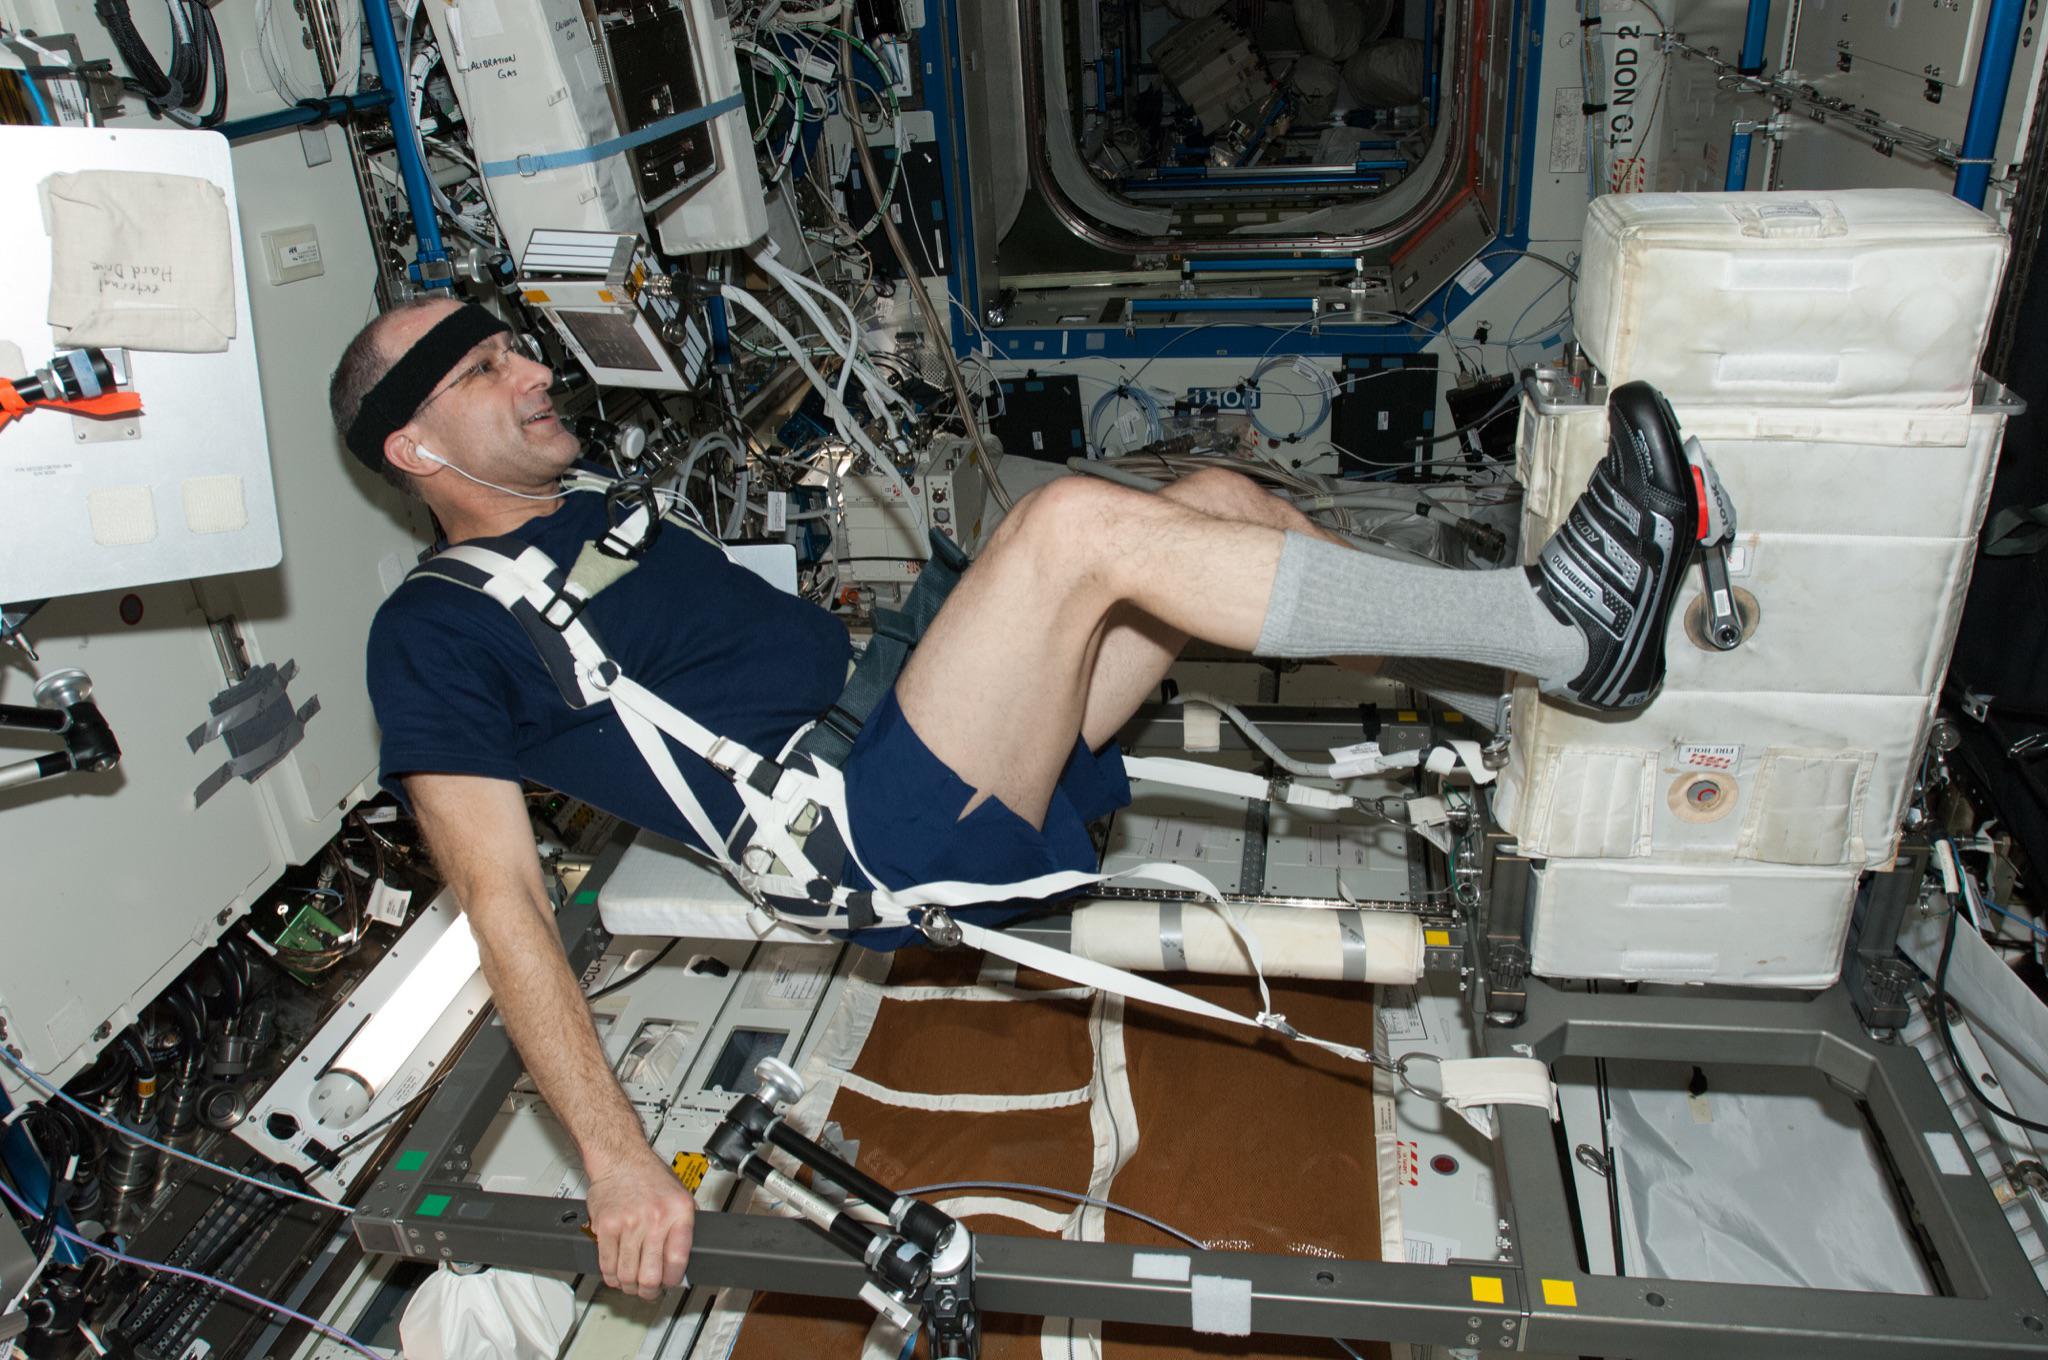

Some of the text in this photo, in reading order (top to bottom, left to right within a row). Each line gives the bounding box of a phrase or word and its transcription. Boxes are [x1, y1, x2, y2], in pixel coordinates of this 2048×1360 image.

[1617, 25, 1640, 40] 2
[468, 54, 517, 72] ALIBRATION
[1612, 48, 1638, 106] NOD
[1609, 114, 1633, 150] TO
[89, 262, 173, 283] Hard Drive
[1711, 483, 1729, 526] LOOK
[1551, 553, 1597, 600] SHIMANO
